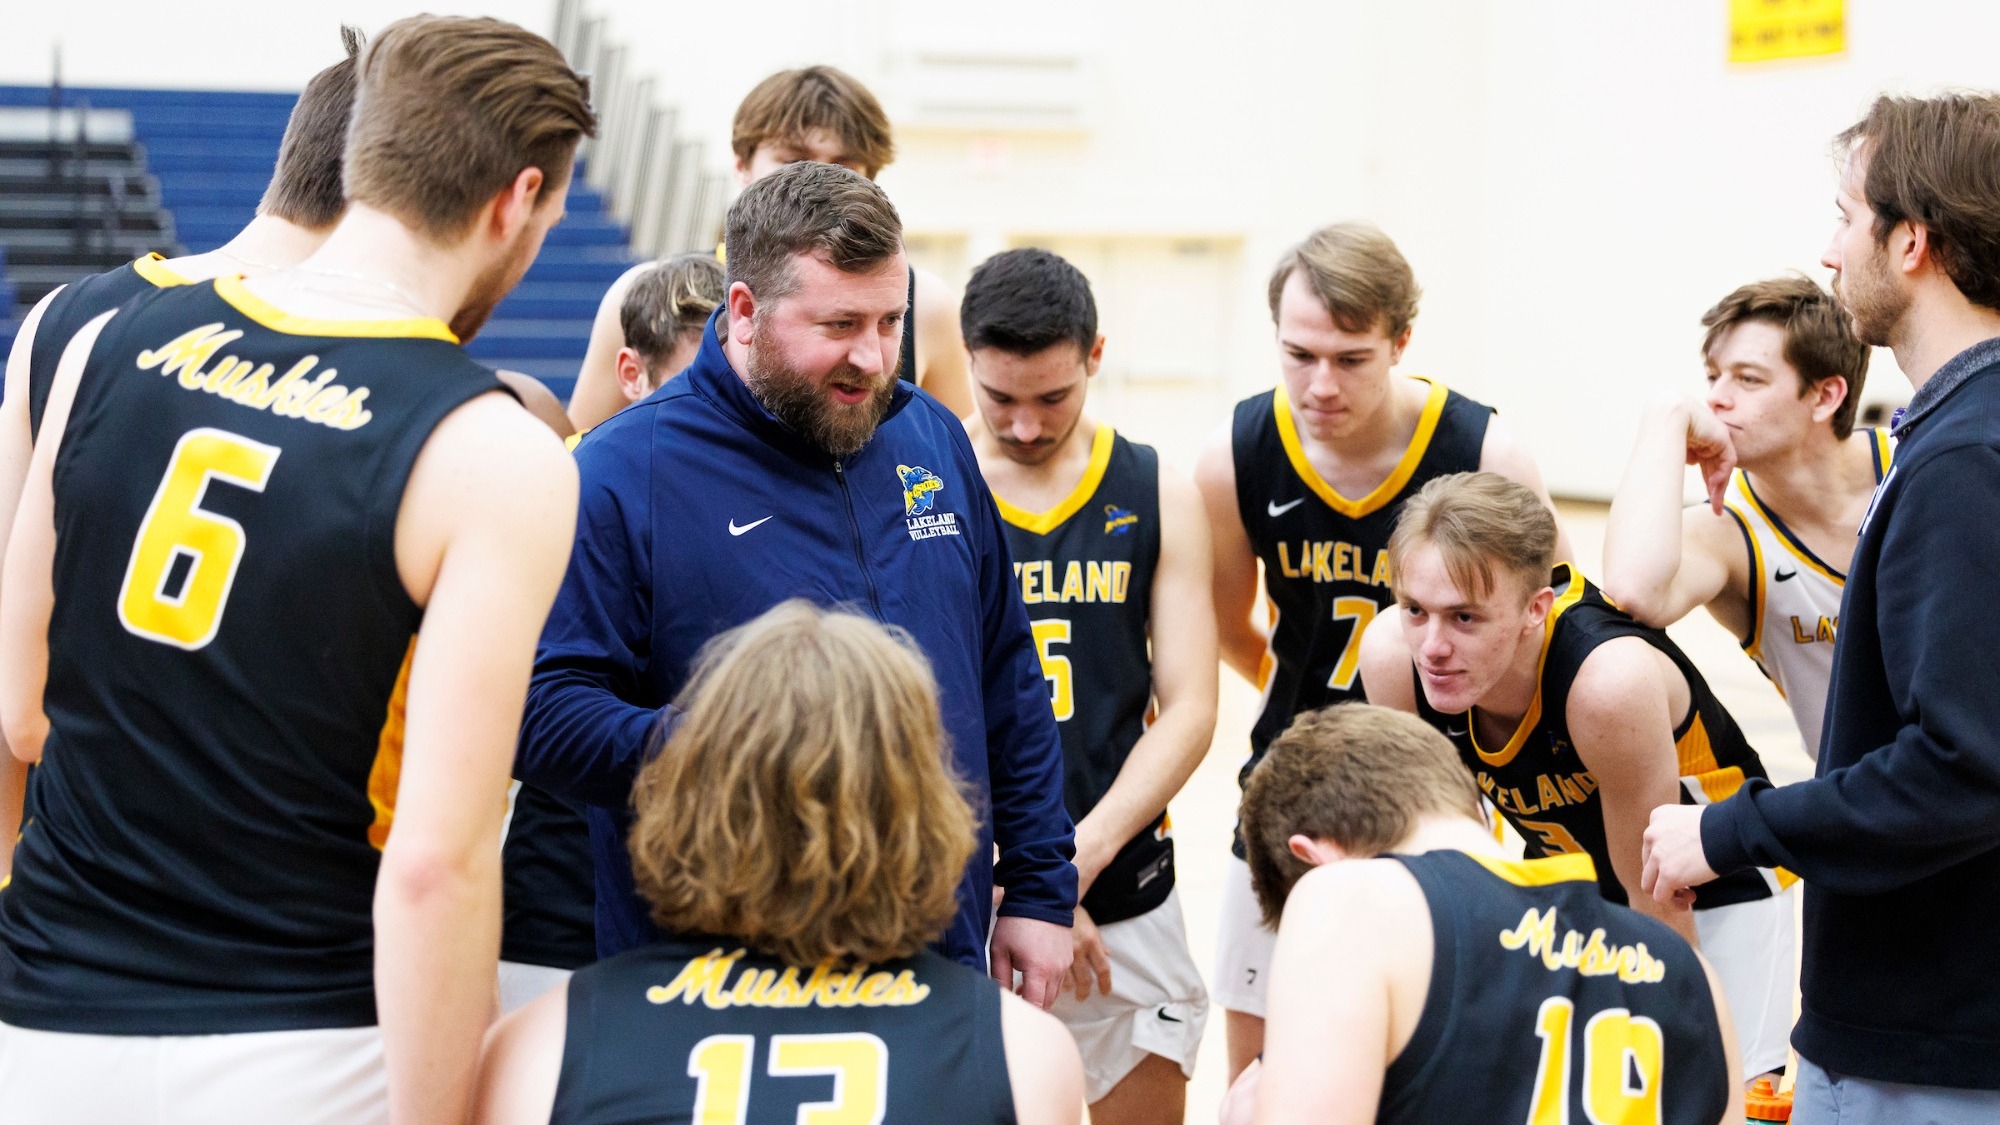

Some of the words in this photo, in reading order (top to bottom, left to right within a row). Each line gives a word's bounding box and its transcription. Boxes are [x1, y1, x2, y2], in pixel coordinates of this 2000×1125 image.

[136, 322, 372, 430] Muskies
[117, 427, 281, 651] 6
[906, 513, 956, 530] LAKELAND
[908, 524, 960, 541] VOLLEYBALL
[1014, 560, 1132, 604] ELAND
[1327, 595, 1378, 691] 7
[1790, 614, 1839, 644] LA
[1030, 618, 1075, 722] 5
[1516, 817, 1579, 857] 3
[646, 948, 931, 1010] Muskies
